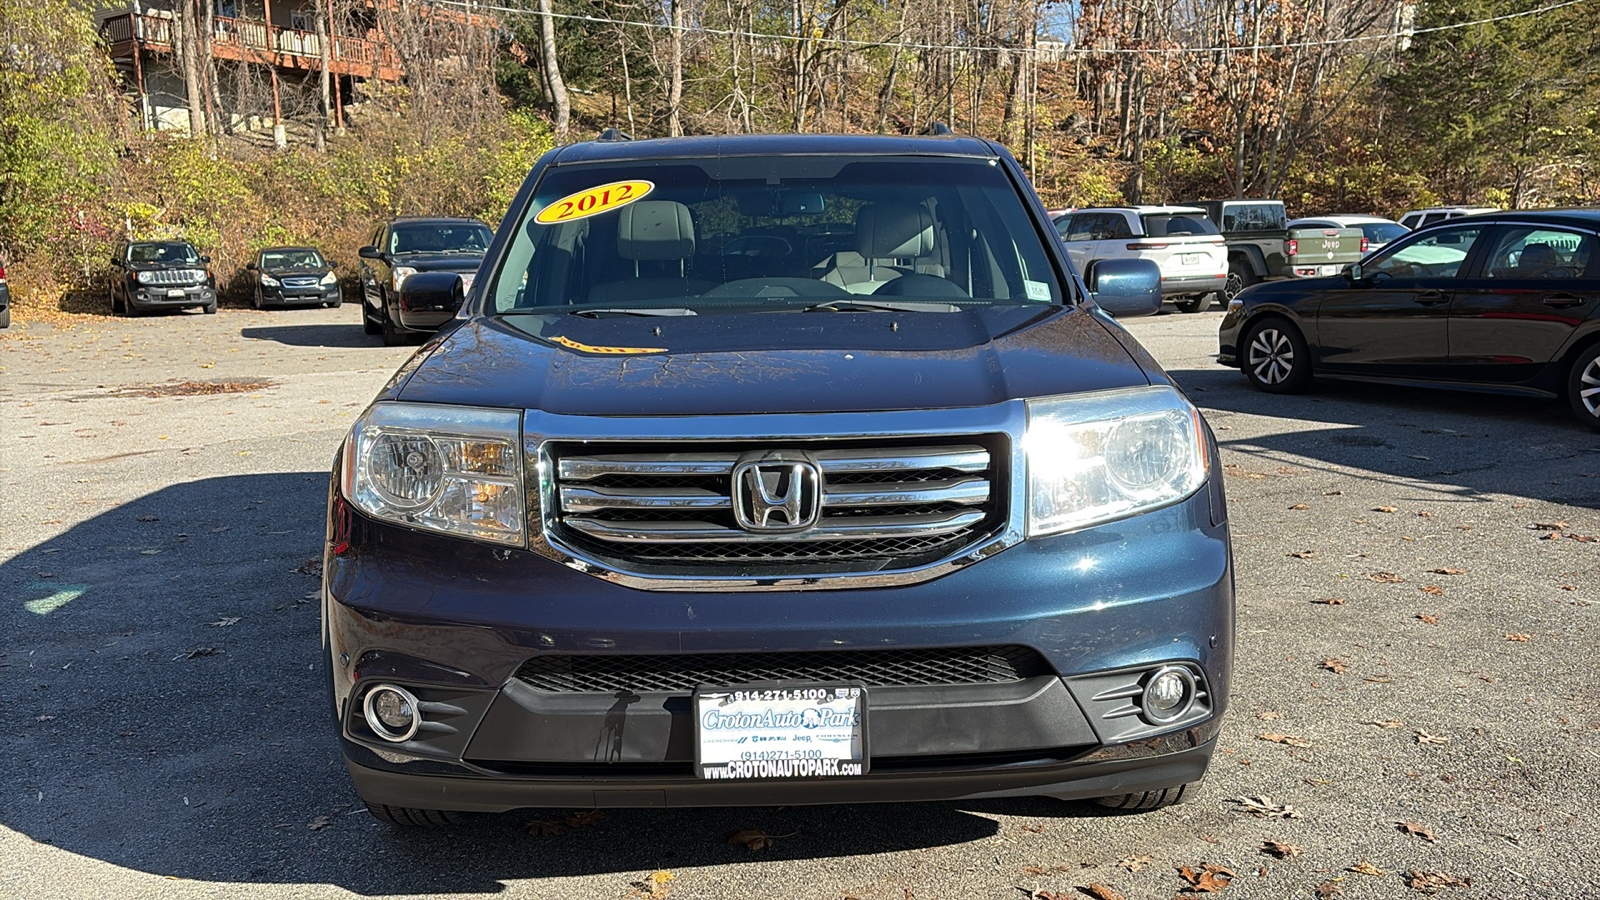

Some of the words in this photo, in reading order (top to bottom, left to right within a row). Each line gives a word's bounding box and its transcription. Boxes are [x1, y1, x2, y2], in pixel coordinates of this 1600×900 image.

[556, 184, 634, 220] 2012
[1322, 240, 1340, 249] Jeep
[735, 688, 826, 701] 914-271-5100
[819, 707, 860, 727] Park
[792, 734, 812, 743] Jeep
[740, 749, 822, 761] (914)271-5100
